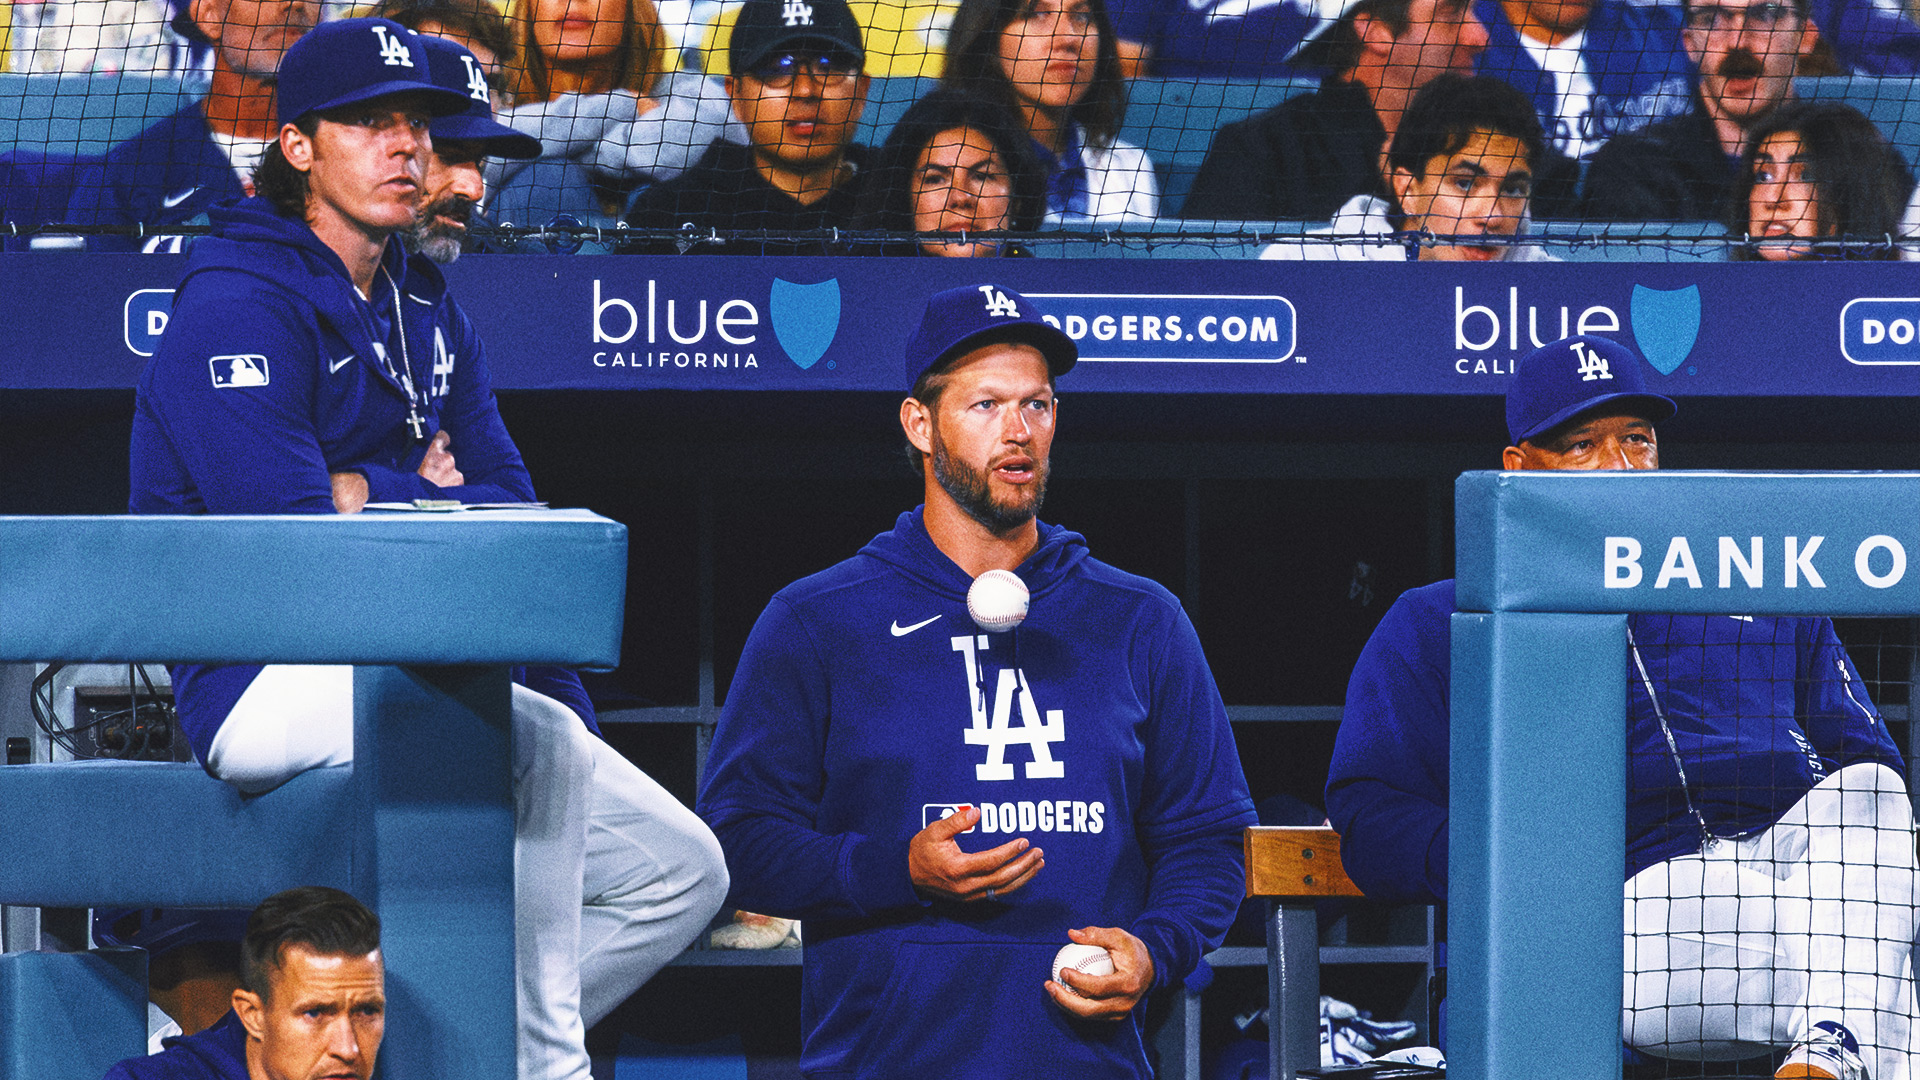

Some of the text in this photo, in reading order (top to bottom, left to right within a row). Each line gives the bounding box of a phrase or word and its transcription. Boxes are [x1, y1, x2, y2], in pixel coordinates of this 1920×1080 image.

[782, 0, 814, 26] LA
[371, 26, 414, 67] LA
[460, 55, 489, 103] LA
[593, 279, 759, 345] blue
[978, 285, 1020, 318] LA
[1455, 286, 1620, 350] blue
[1862, 318, 1920, 345] DO
[593, 352, 759, 368] CALIFORNIA
[1569, 342, 1613, 381] LA
[1603, 534, 1907, 590] BANK O
[951, 634, 1066, 781] LA
[980, 800, 1105, 834] DODGERS
